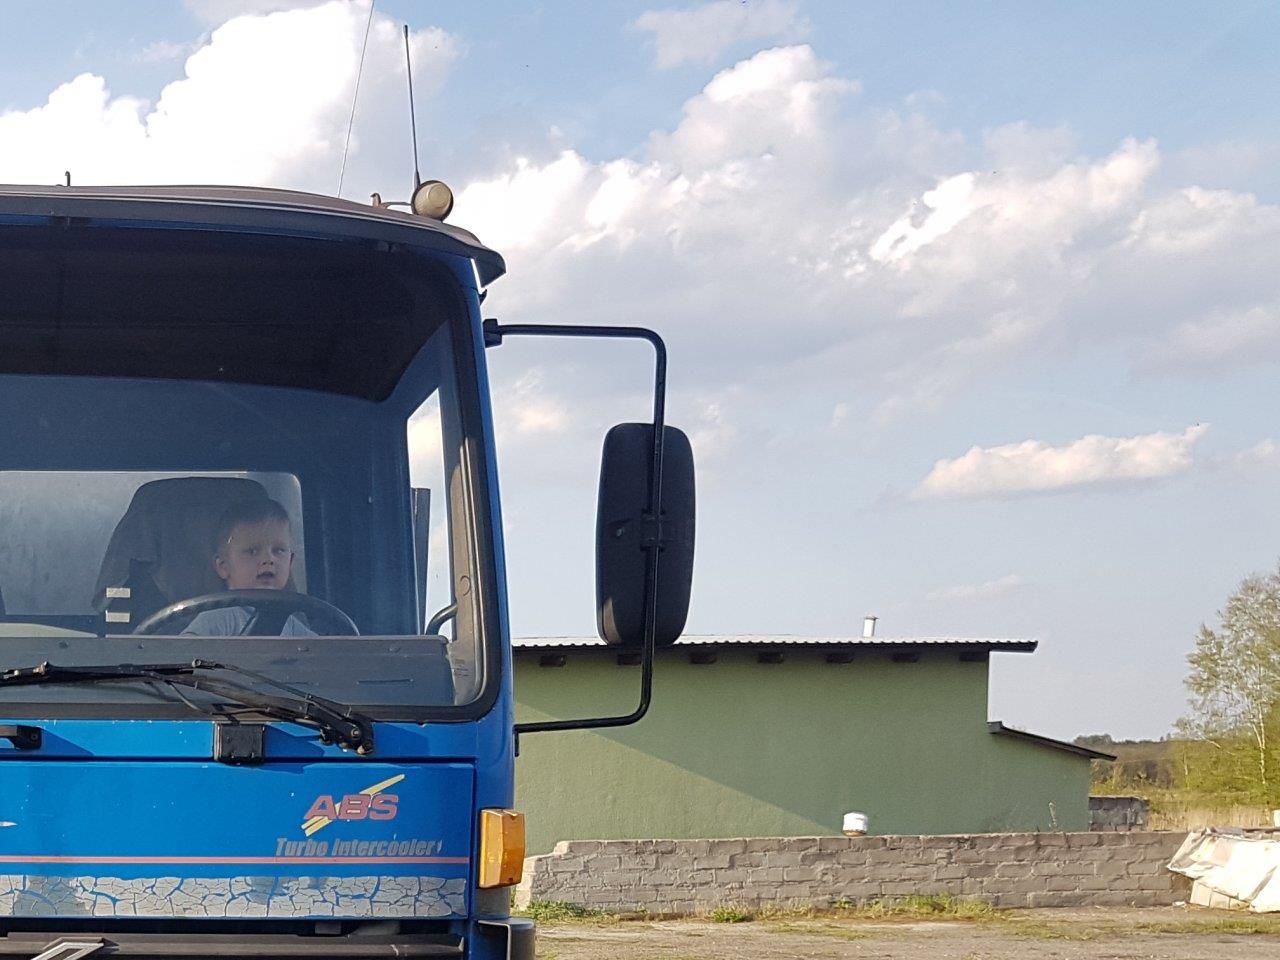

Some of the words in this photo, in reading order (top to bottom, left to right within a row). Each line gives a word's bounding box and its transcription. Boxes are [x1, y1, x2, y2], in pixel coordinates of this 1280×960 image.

[304, 793, 399, 821] ABS
[275, 838, 328, 856] Turbo
[332, 838, 437, 857] Intercooler
